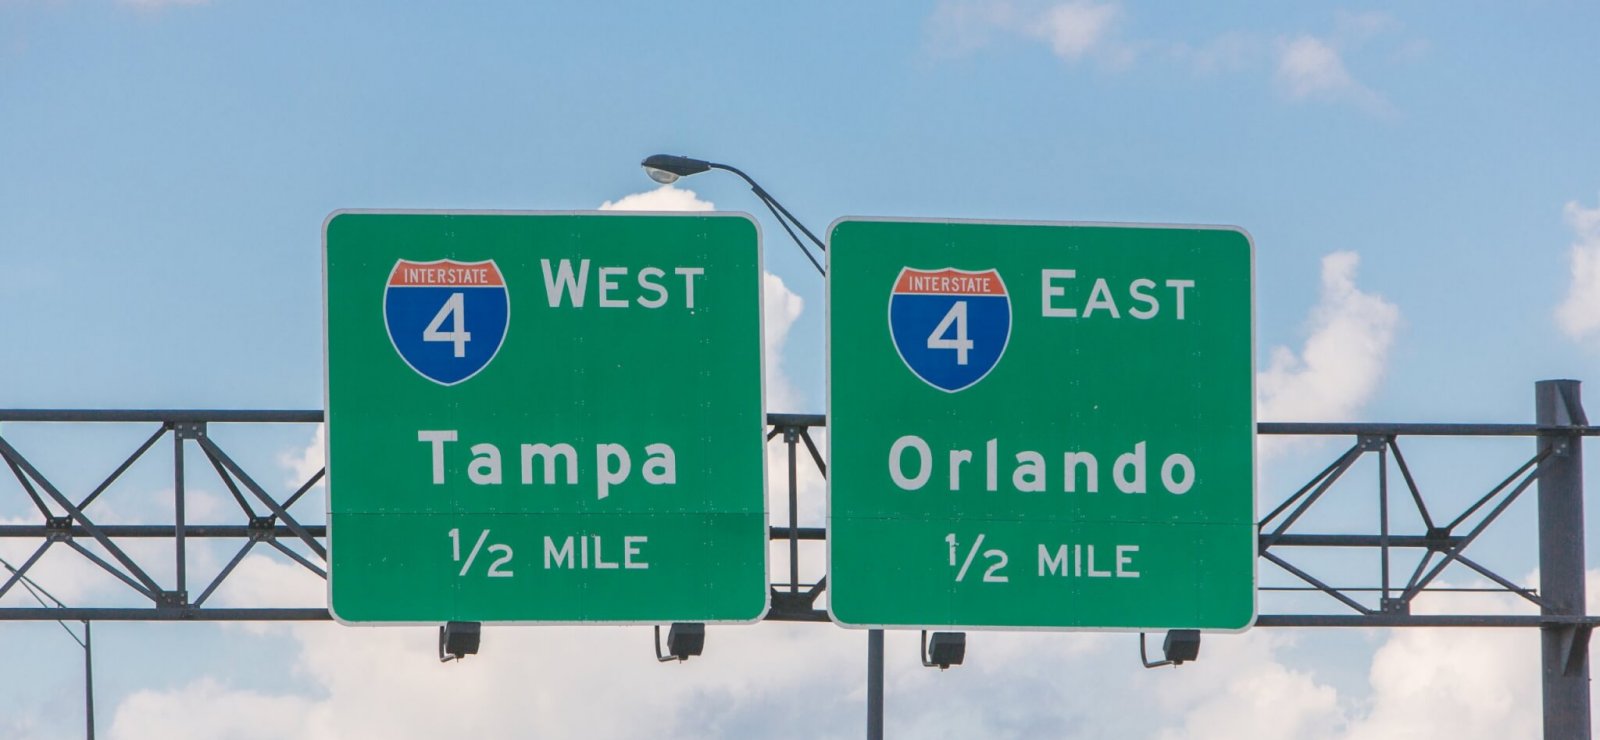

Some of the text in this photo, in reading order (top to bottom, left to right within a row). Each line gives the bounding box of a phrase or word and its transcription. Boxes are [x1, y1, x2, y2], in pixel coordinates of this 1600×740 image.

[404, 268, 489, 285] INTERSTATE
[909, 276, 991, 294] INTERSTATE
[423, 293, 471, 358] 4
[927, 301, 974, 366] 4
[418, 430, 677, 499] Tampa
[888, 435, 1196, 495] Orlando
[544, 535, 649, 569] MILE
[1038, 543, 1140, 577] MILE
